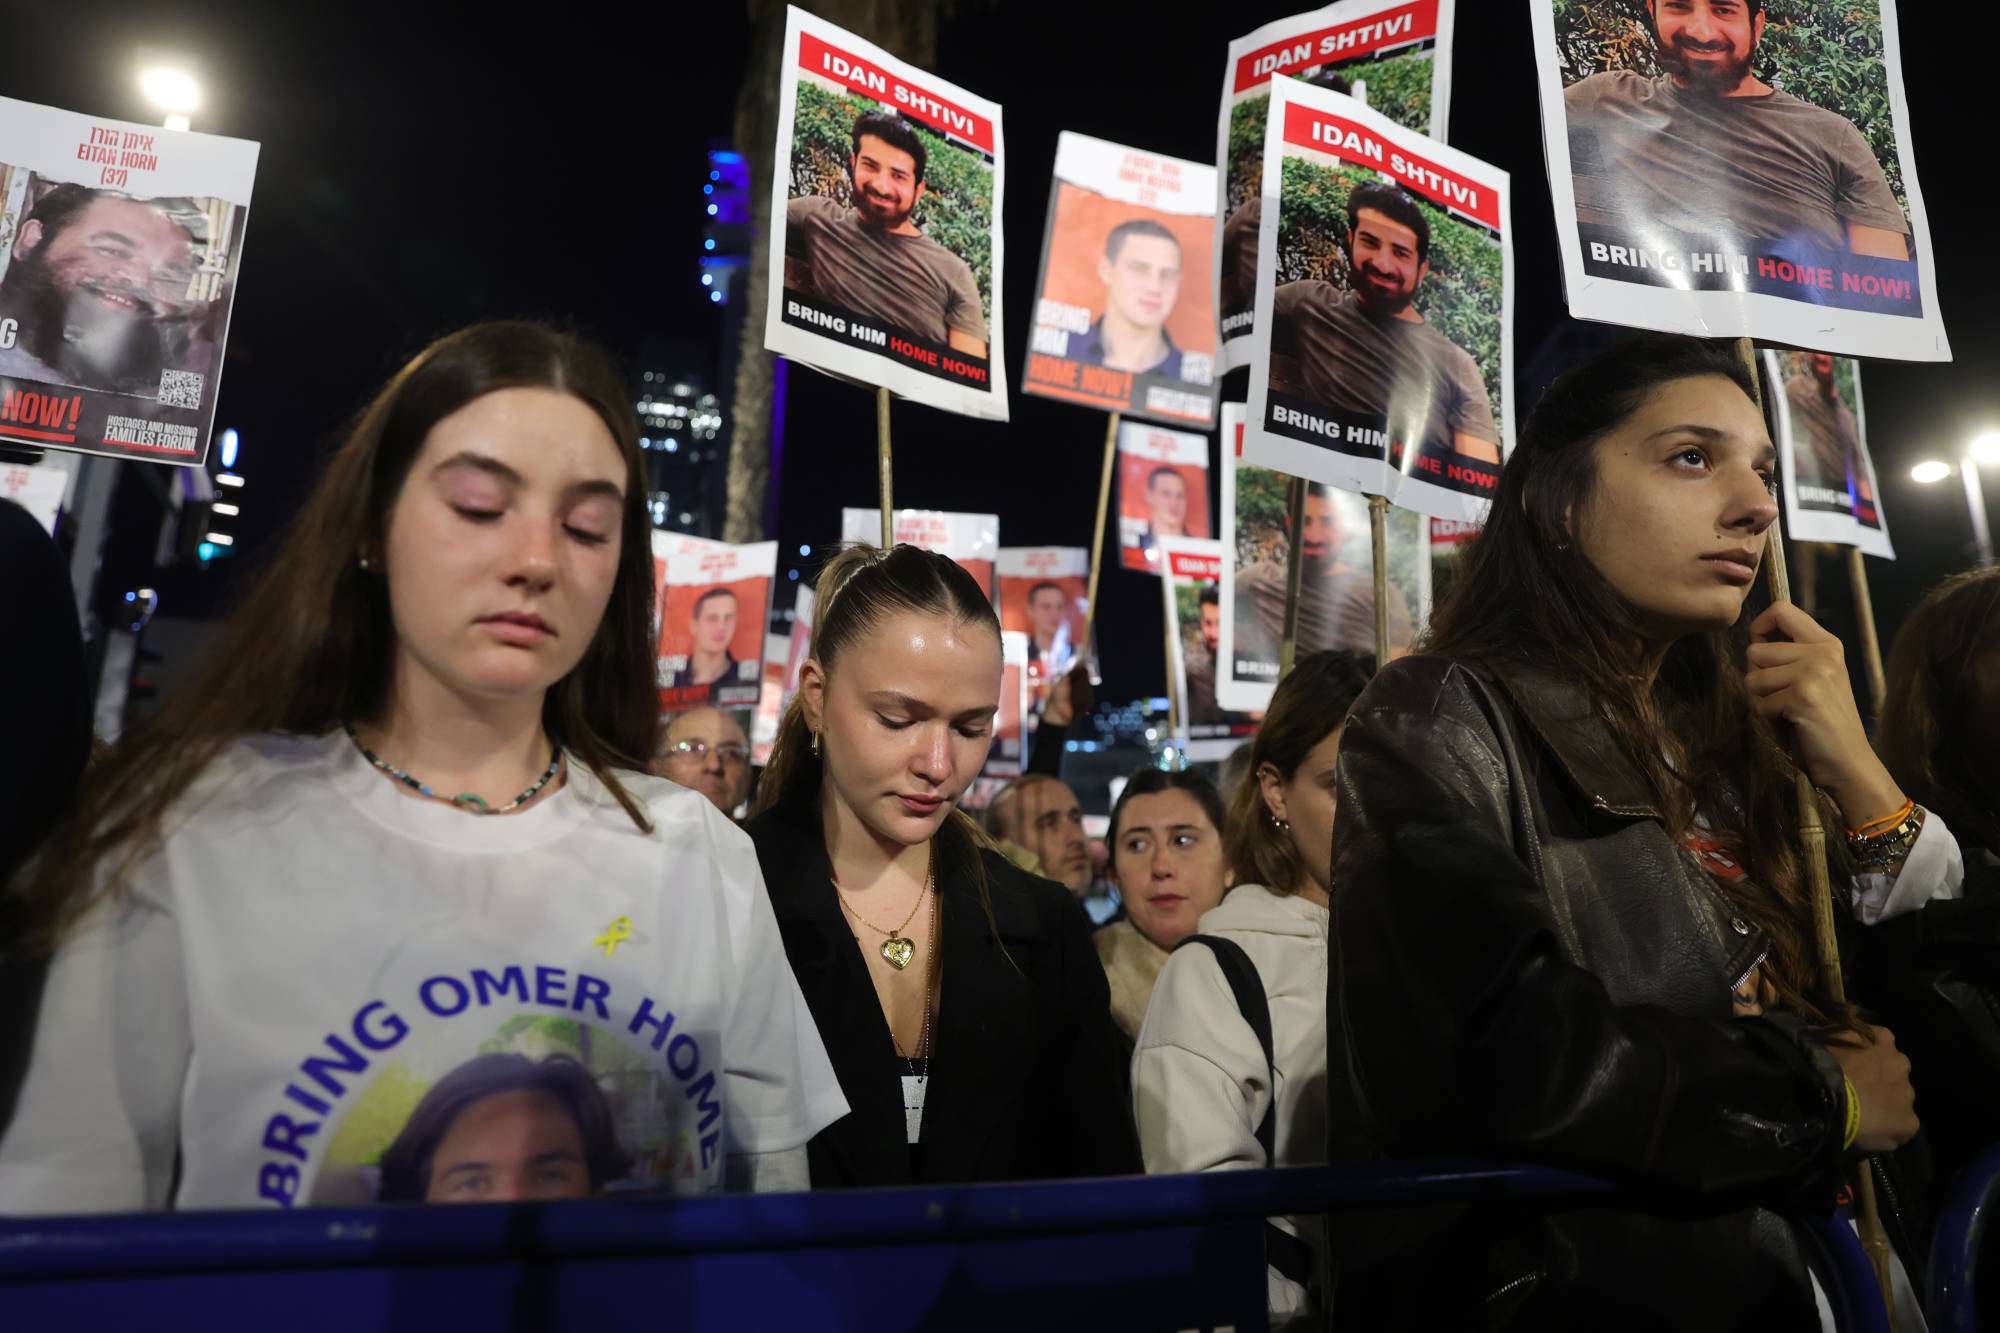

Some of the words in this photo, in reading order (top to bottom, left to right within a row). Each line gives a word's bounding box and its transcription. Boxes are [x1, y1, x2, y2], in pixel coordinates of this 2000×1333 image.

[1253, 42, 1312, 77] IDAN
[1319, 13, 1413, 55] SHTIVI
[823, 52, 886, 94] IDAN
[894, 84, 974, 135] SHTIVI
[77, 143, 117, 165] EITAN
[120, 151, 158, 171] HORN
[90, 127, 119, 146] הורן
[122, 132, 154, 152] איתן
[100, 166, 128, 188] (37)
[1312, 121, 1383, 162] IDAN
[1390, 153, 1477, 209] SHTIVI
[1590, 241, 1682, 271] BRING
[1691, 252, 1749, 275] HIM
[1757, 257, 1834, 289] HOME
[1842, 271, 1912, 300] NOW!
[788, 300, 846, 333] BRING
[851, 323, 886, 346] HIM
[890, 336, 938, 367] HOME
[942, 357, 986, 382] NOW!
[1, 388, 81, 430] NOW!
[107, 415, 147, 430] HOSTAGES
[148, 421, 164, 433] AND
[164, 423, 198, 437] MISSING
[105, 426, 155, 447] FAMILIES
[156, 433, 197, 452] FORUM
[1272, 404, 1340, 438] BRING
[1347, 425, 1388, 449] HIM
[1391, 440, 1442, 474] HME
[258, 1001, 410, 1208] BRING
[419, 966, 612, 1020] OMER
[628, 997, 722, 1170] HOME
